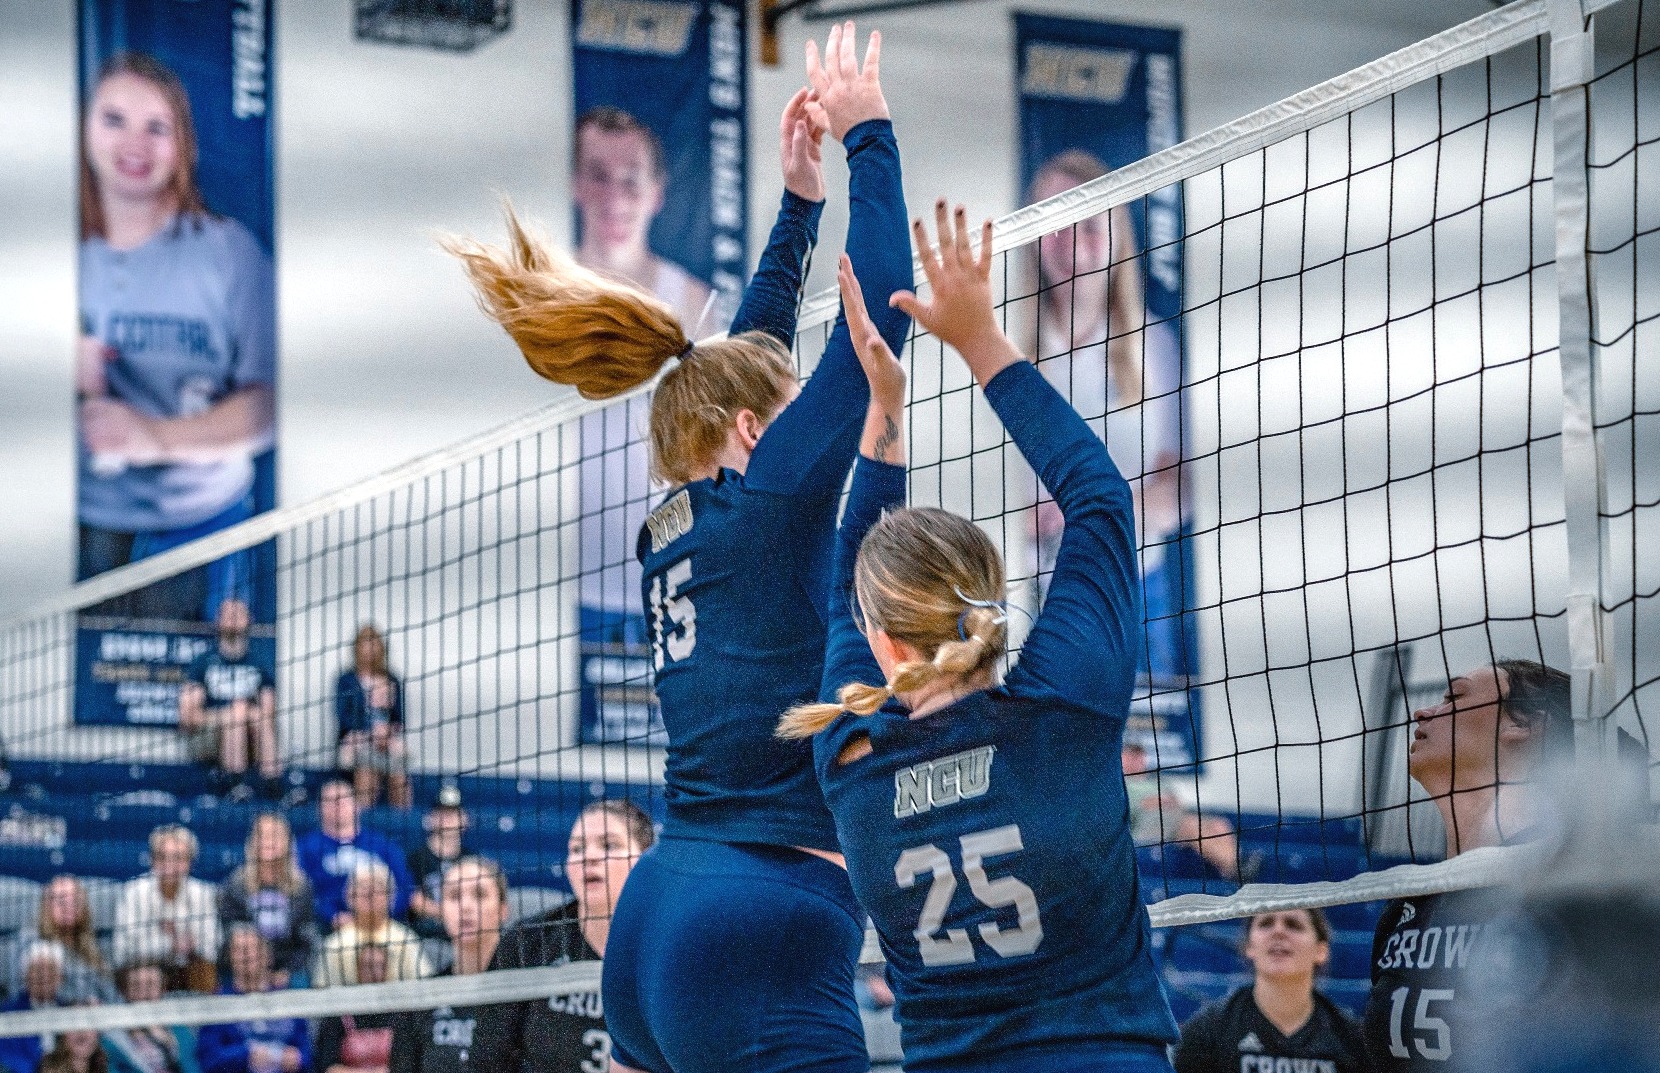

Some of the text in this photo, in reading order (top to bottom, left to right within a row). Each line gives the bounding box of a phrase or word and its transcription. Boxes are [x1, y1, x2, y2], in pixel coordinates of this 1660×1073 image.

[646, 488, 694, 554] NCU
[893, 745, 997, 819] NCU
[893, 824, 1044, 967] 25
[1377, 924, 1483, 969] CROW
[549, 992, 604, 1019] CRO
[1388, 986, 1455, 1061] 15
